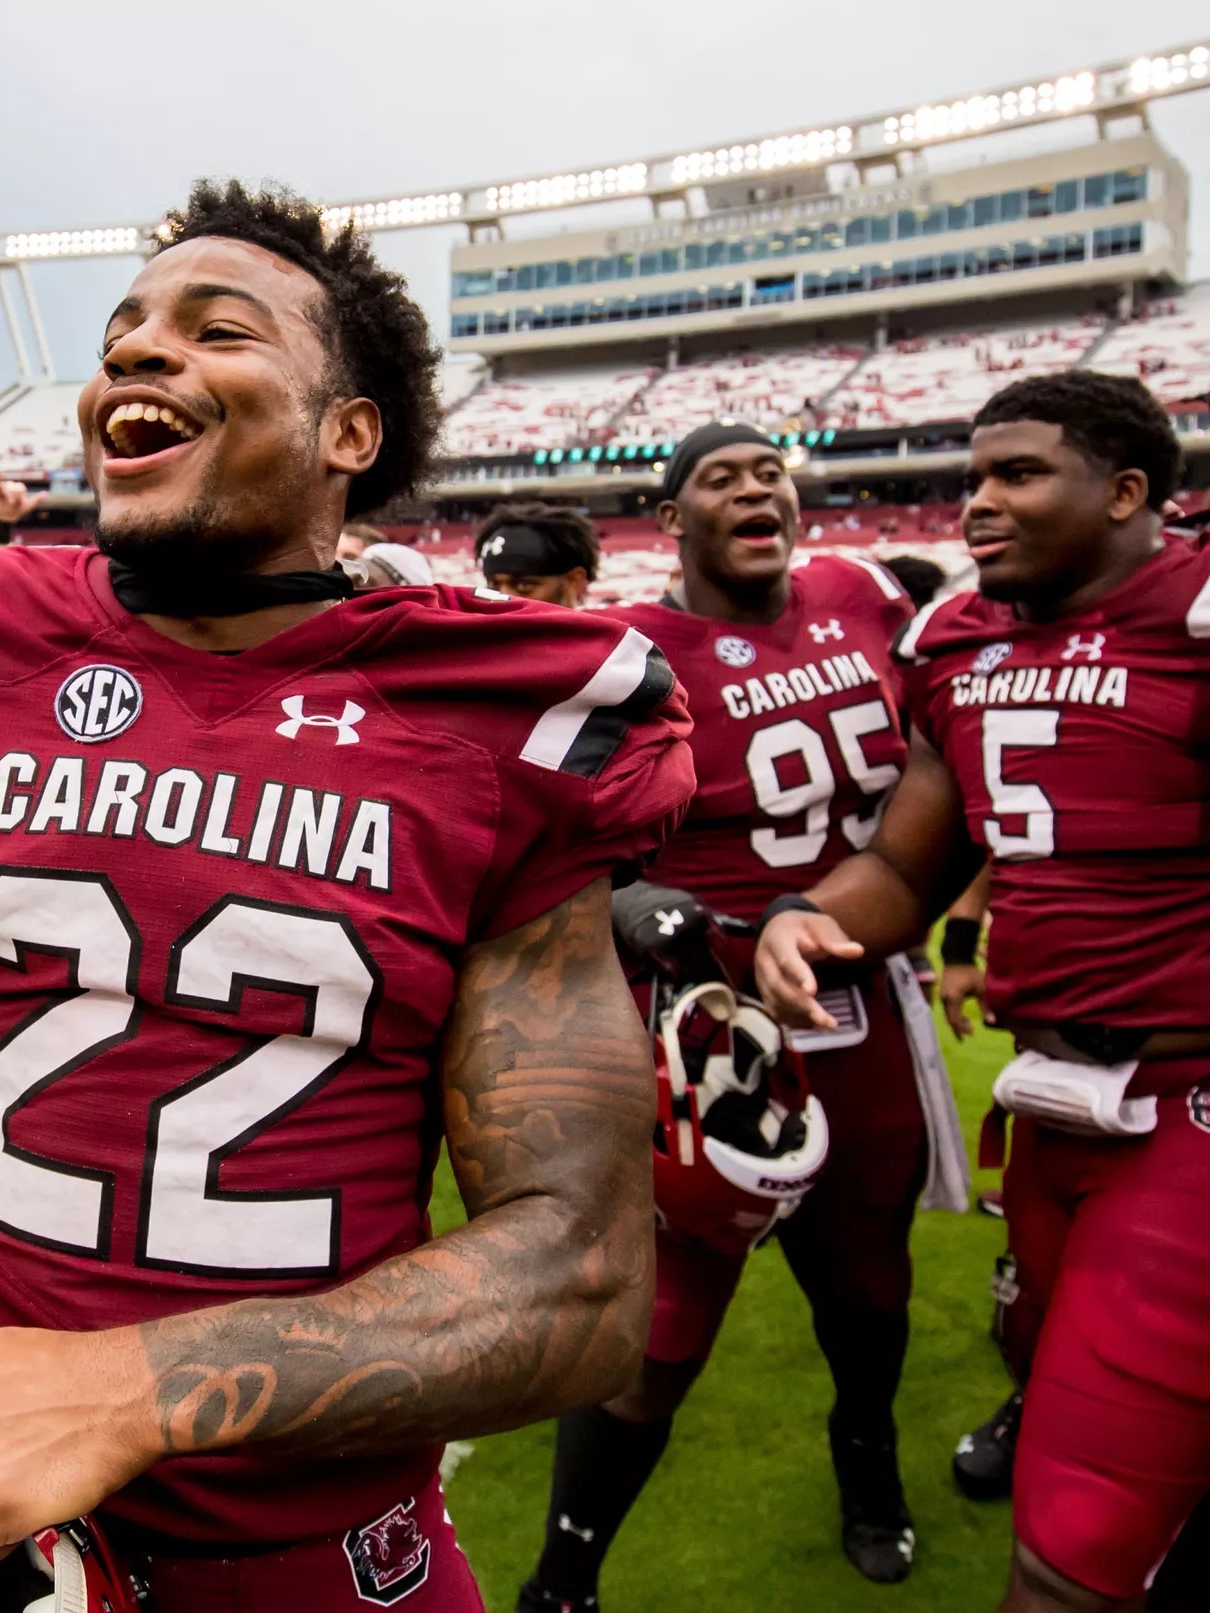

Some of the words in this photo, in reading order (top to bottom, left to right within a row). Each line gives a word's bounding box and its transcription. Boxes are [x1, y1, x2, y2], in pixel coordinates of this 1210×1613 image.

[60, 667, 139, 740] SEC
[721, 650, 878, 719] CAROLINA
[951, 666, 1128, 707] CAROLINA
[745, 699, 901, 869] 95
[982, 709, 1056, 860] 5
